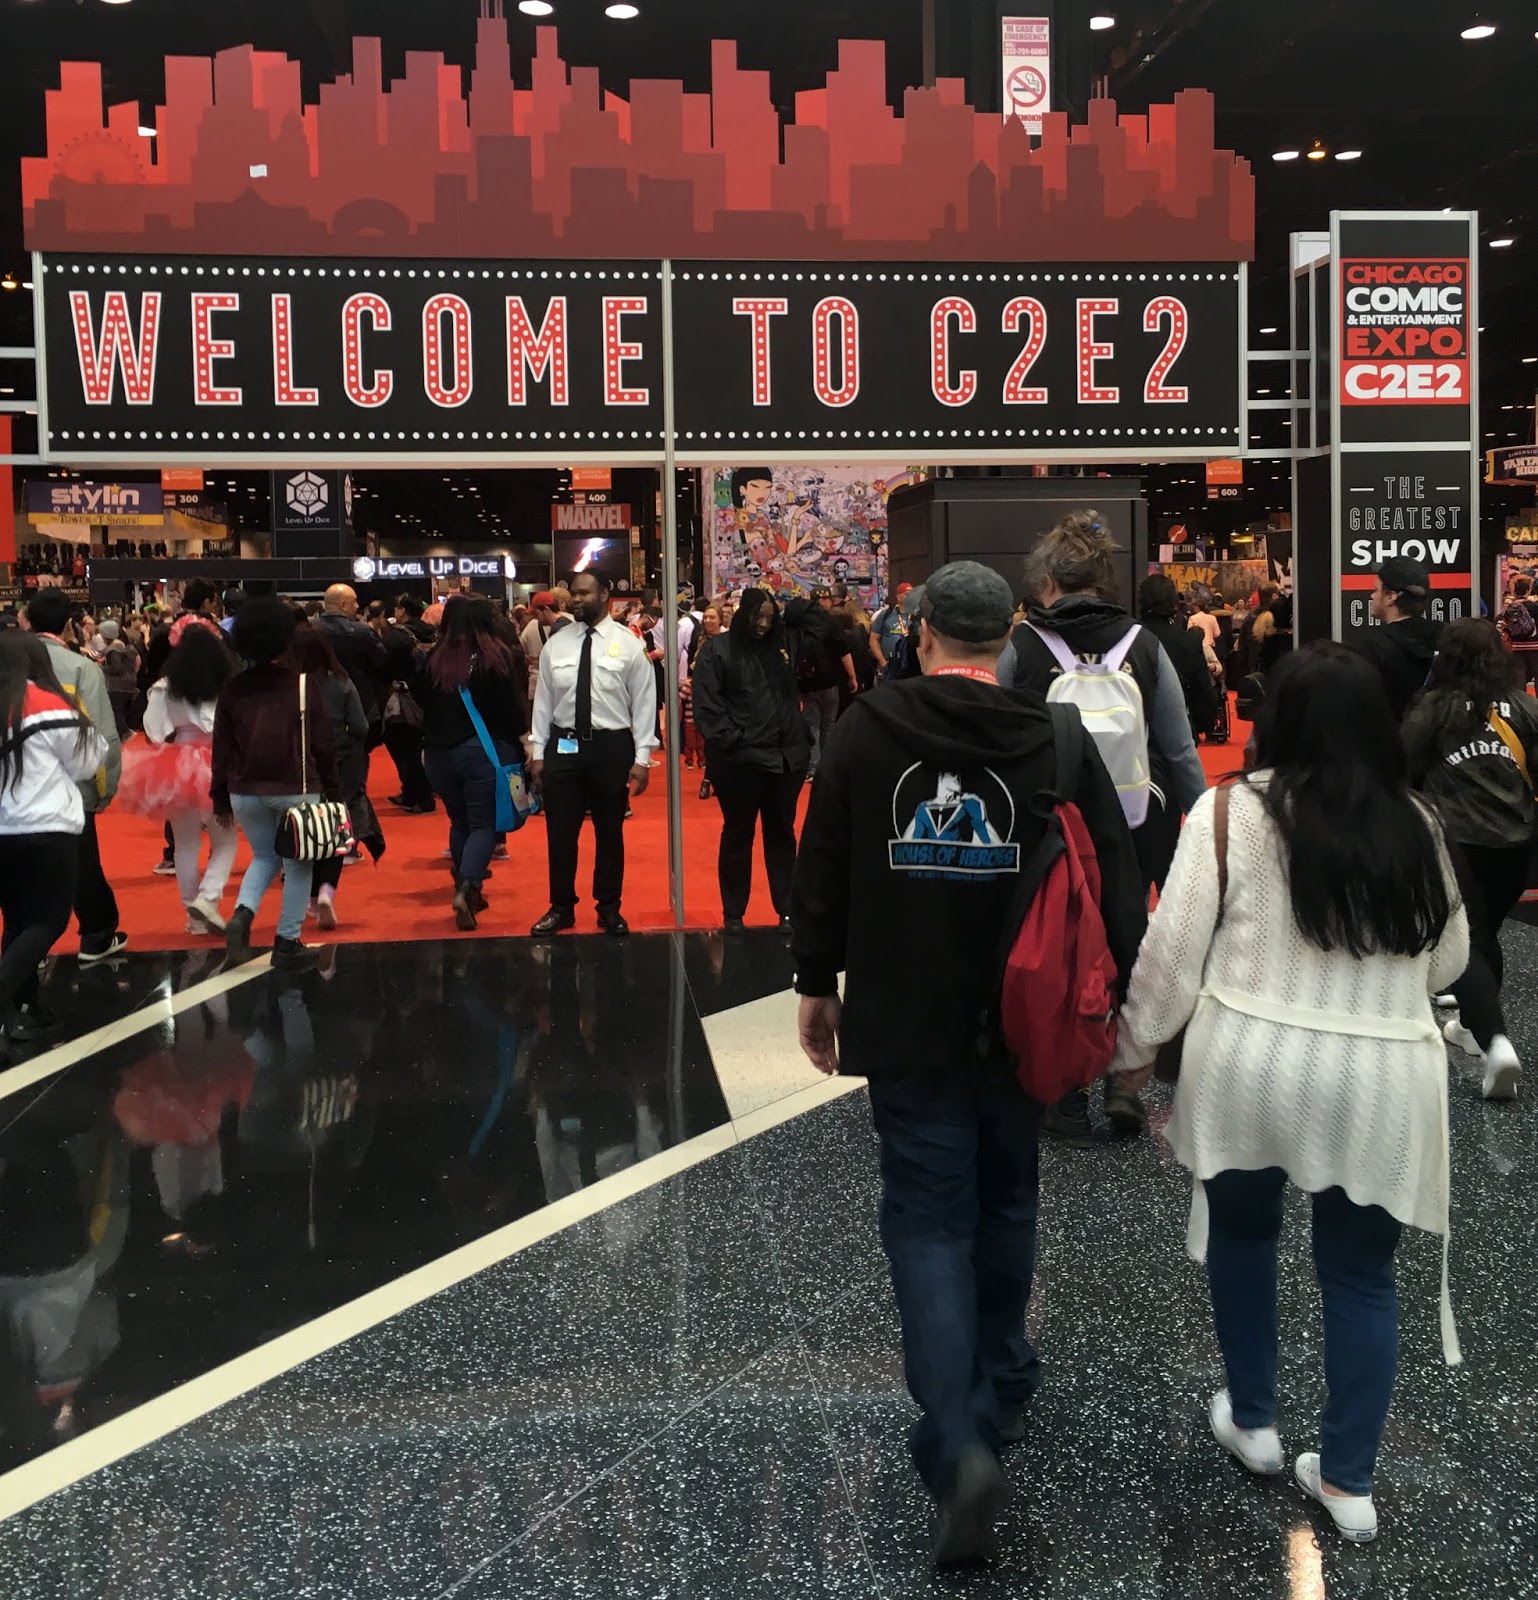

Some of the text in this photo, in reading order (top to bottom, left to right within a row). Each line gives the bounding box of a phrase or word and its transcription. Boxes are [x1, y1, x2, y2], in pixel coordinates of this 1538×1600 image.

[1346, 265, 1462, 284] CHICAGO
[1346, 286, 1462, 312] COMIC
[1347, 314, 1462, 325] & ENTERTAINMENT
[69, 290, 1188, 408] WELCOME TO C2E2
[1347, 326, 1463, 356] EXPO
[1345, 364, 1462, 398] C2E2
[1503, 456, 1538, 470] FANTA
[51, 484, 140, 510] stylin
[180, 494, 198, 504] 300
[588, 493, 606, 502] 400
[1221, 488, 1238, 496] 600
[1384, 476, 1425, 499] THE
[53, 506, 123, 514] ONLINE
[557, 505, 624, 530] MARVEL
[1350, 506, 1461, 530] GREATEST
[1351, 538, 1461, 566] SHOW
[1163, 564, 1218, 587] HEAVY
[895, 843, 1016, 868] HOUSE OF HEROES
